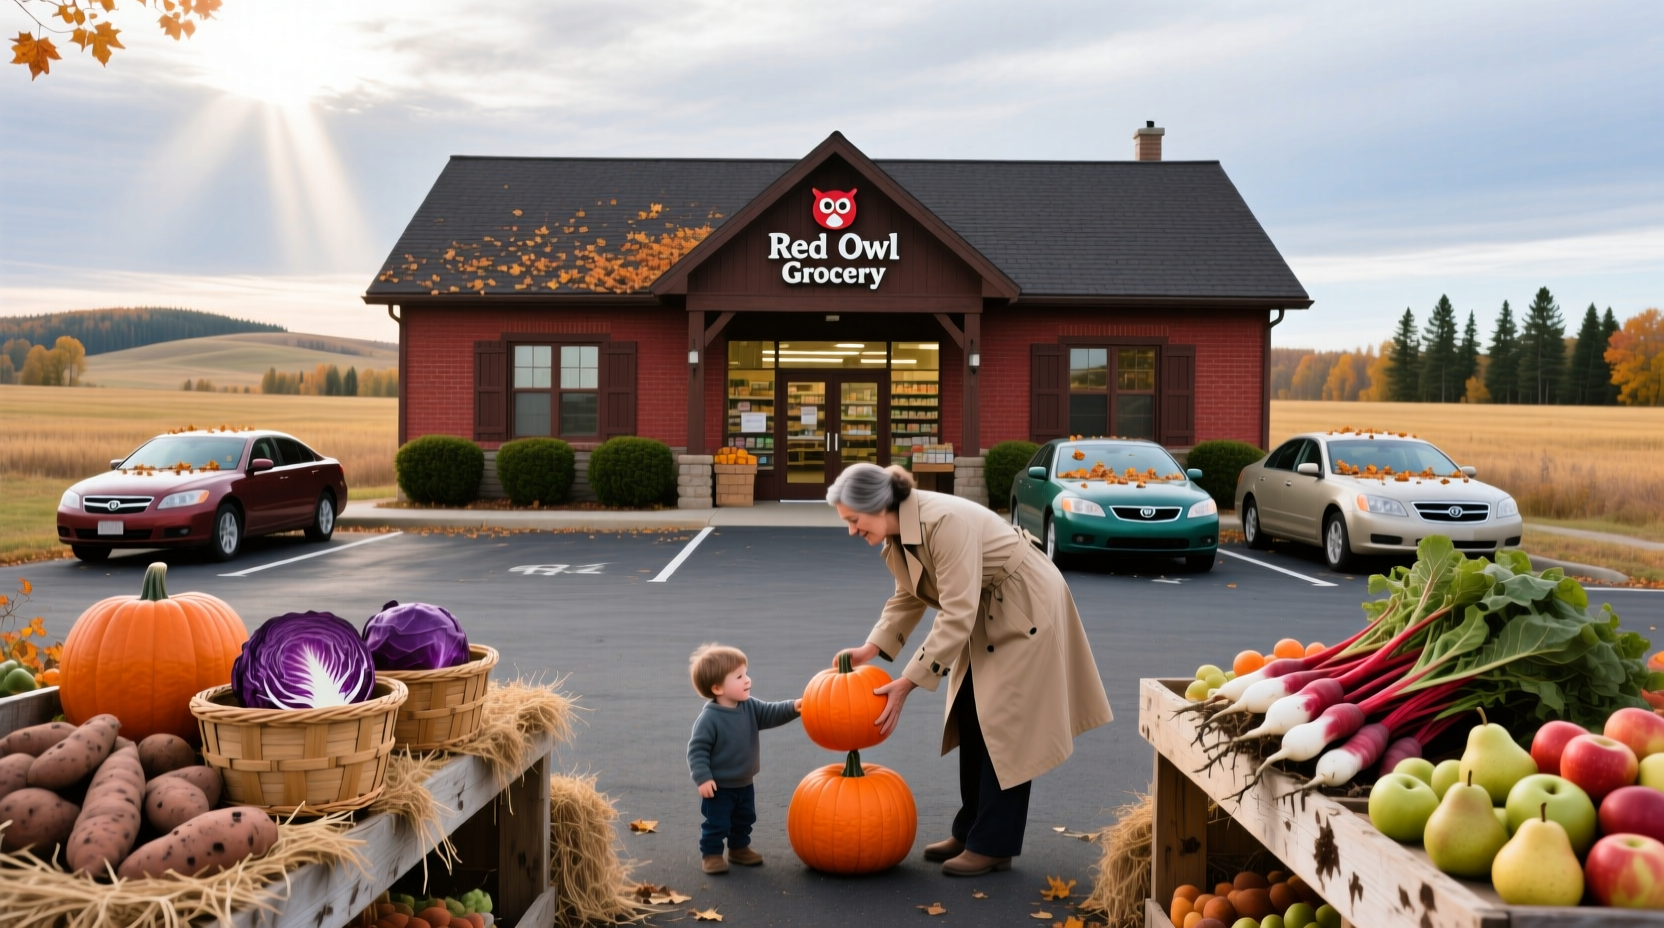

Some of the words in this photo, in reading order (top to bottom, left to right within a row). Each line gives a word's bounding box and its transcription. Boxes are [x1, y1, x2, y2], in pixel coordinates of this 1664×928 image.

[768, 232, 828, 260] Red
[838, 232, 900, 260] Owl
[782, 261, 886, 290] Grocery
